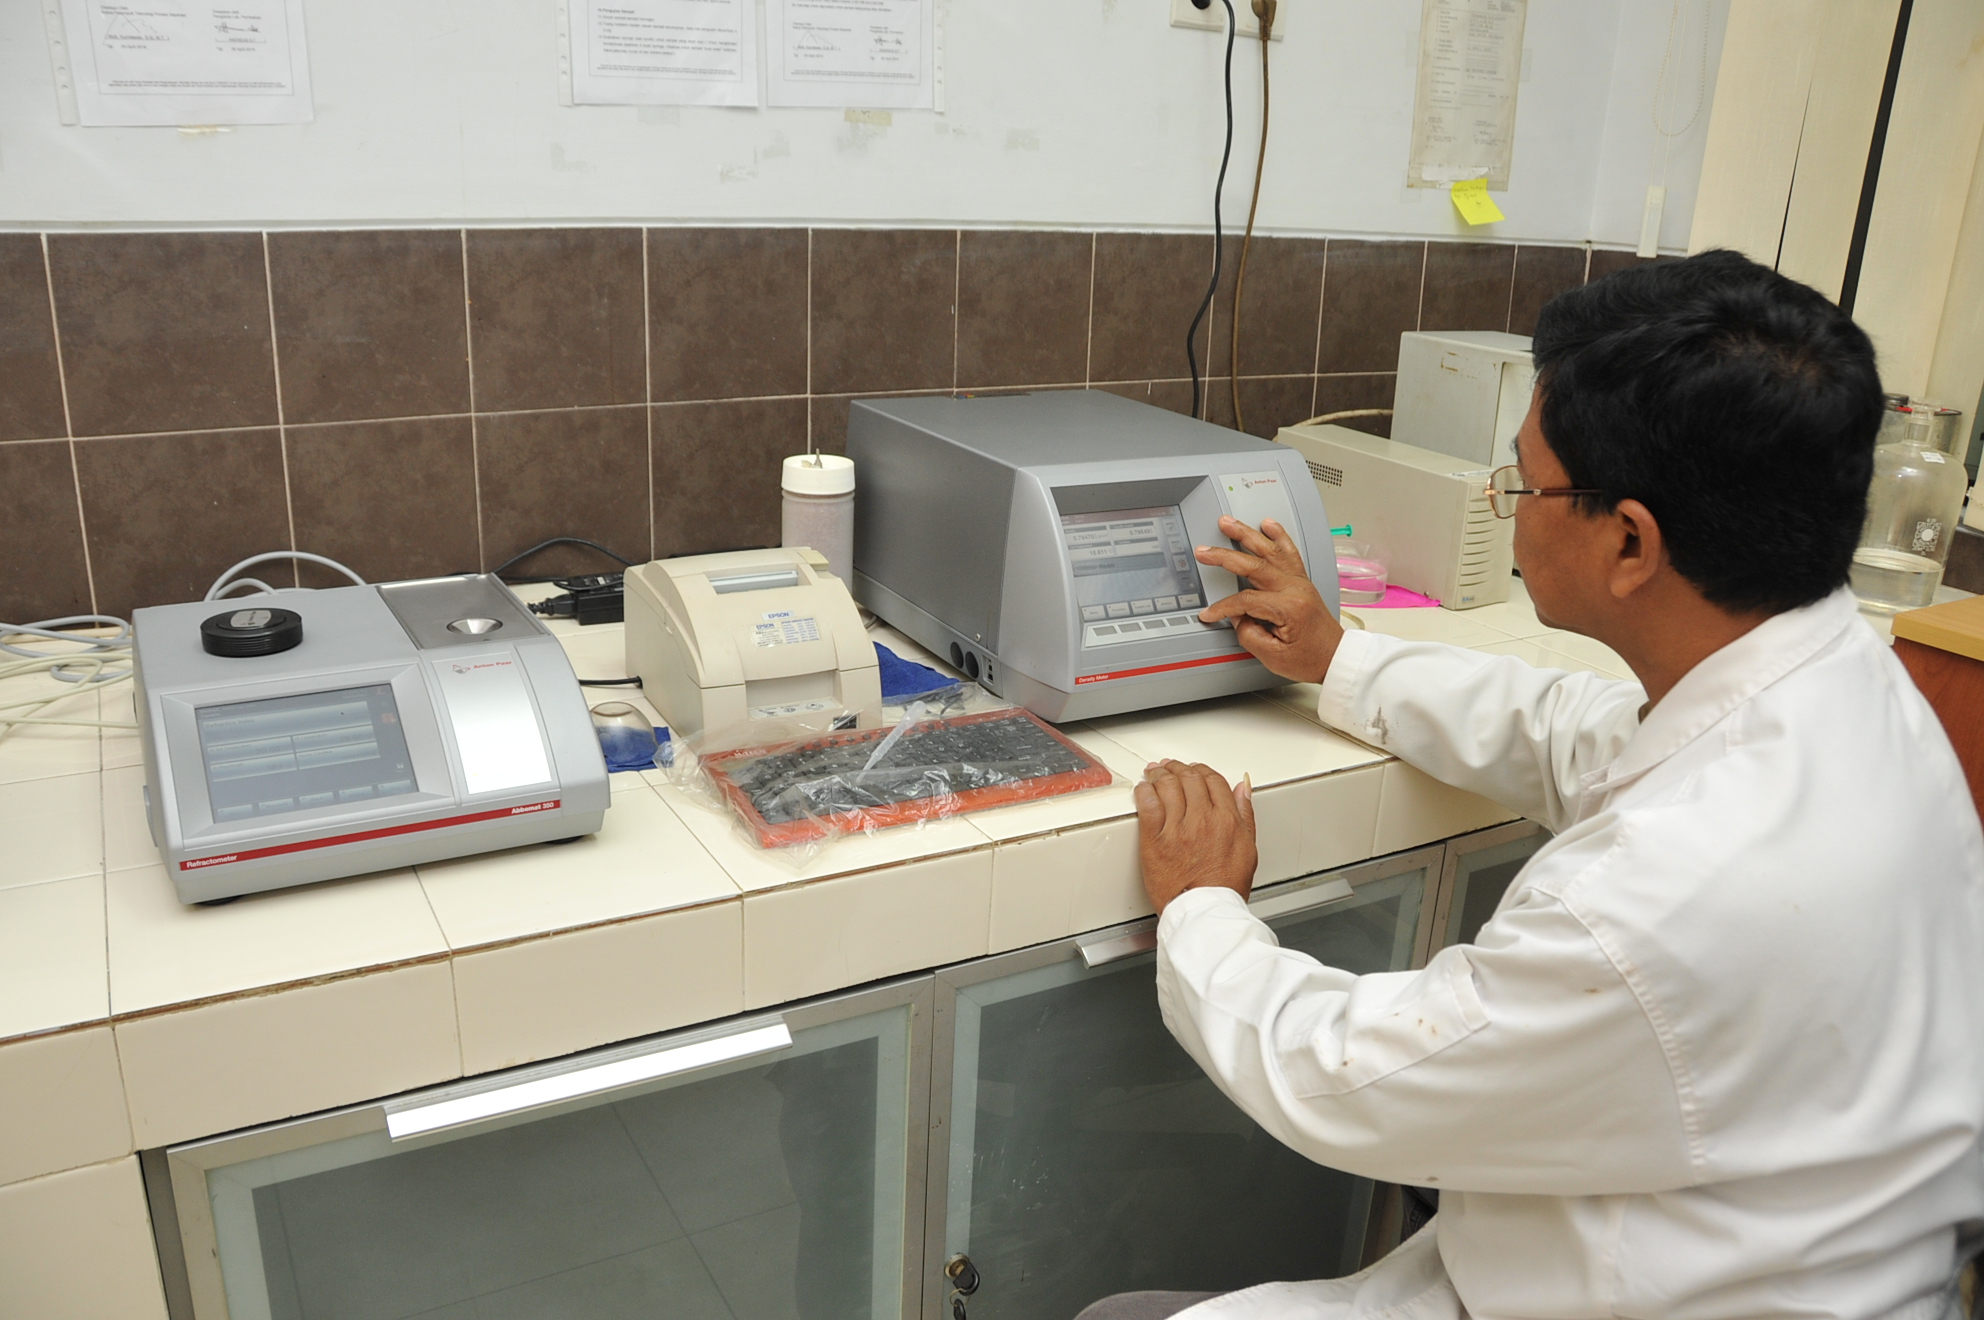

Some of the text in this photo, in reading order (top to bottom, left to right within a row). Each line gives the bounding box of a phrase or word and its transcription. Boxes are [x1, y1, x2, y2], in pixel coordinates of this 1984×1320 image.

[511, 801, 554, 814] Abbemat 350
[186, 855, 238, 868] Refractometer
